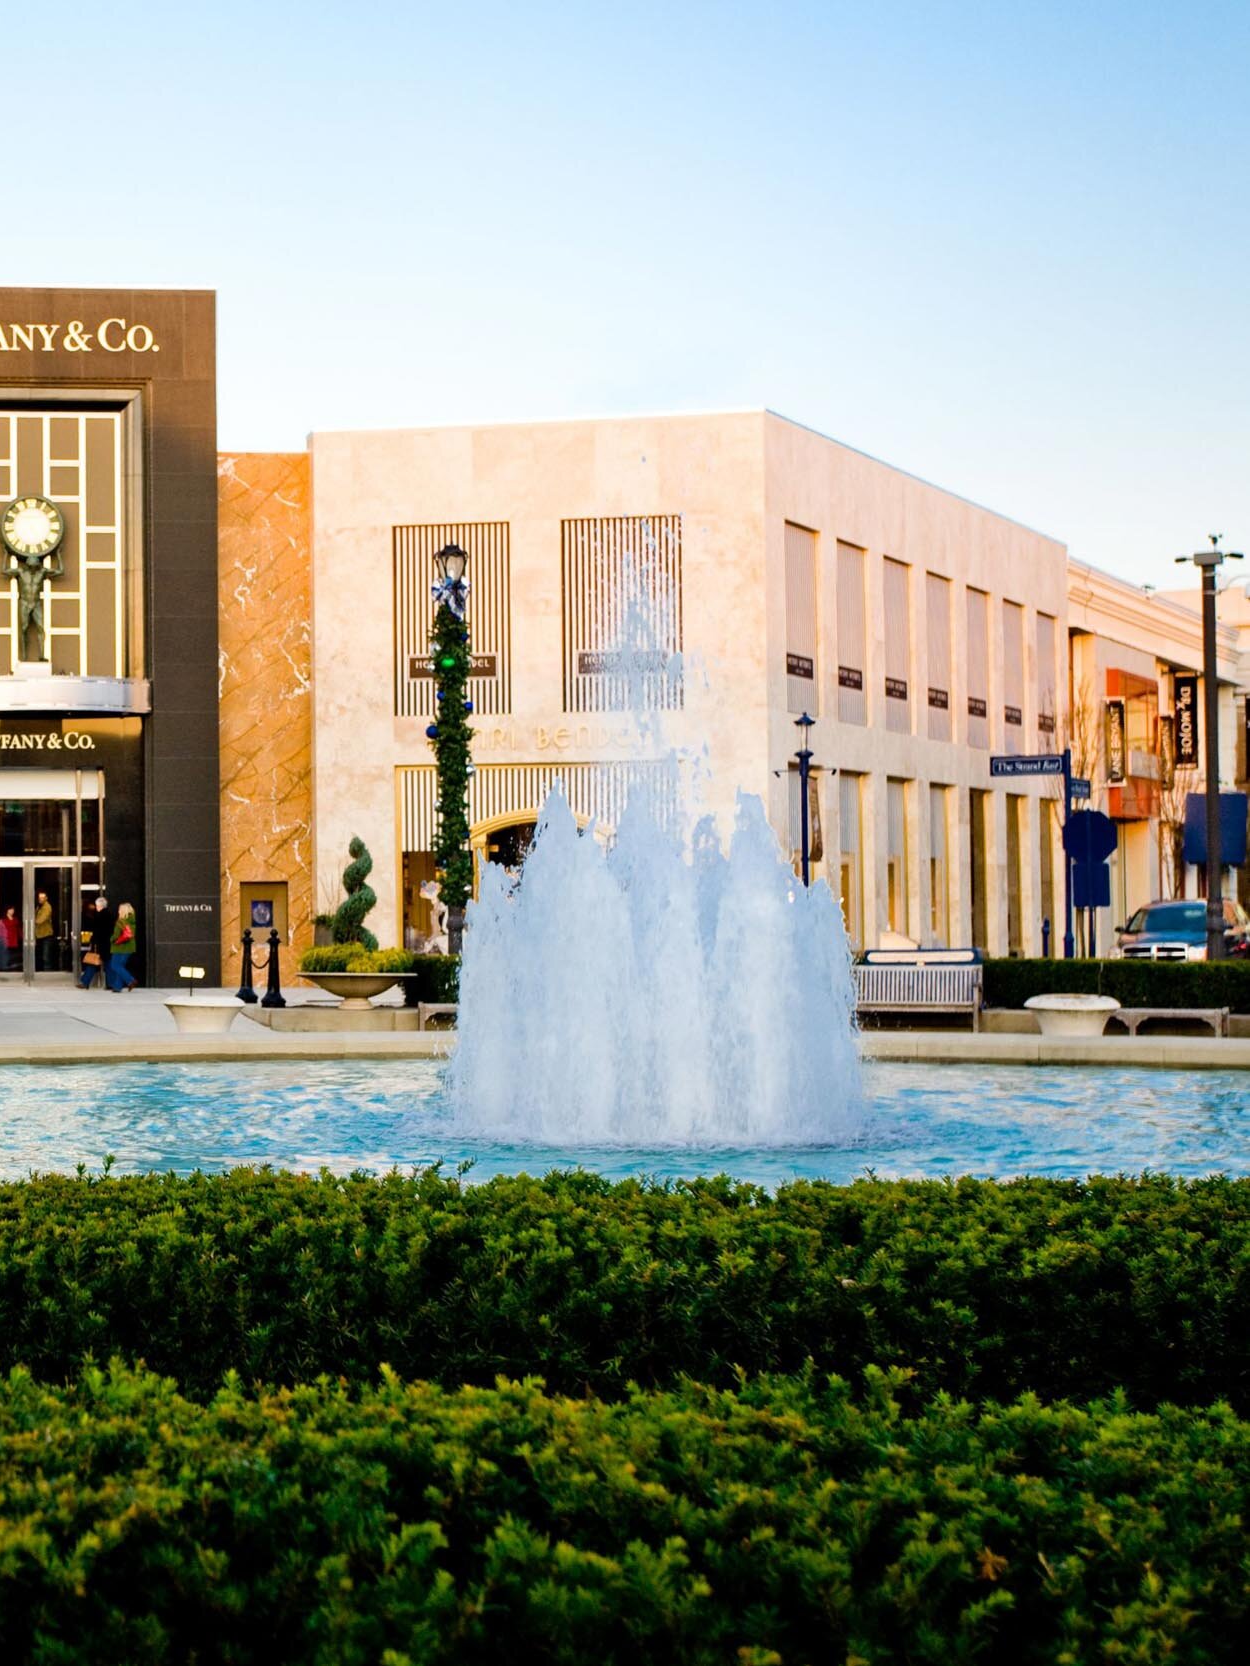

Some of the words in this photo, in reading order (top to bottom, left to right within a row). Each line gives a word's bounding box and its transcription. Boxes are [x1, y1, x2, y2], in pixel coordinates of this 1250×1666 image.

[62, 320, 93, 352] &
[97, 318, 160, 353] CO.
[47, 732, 62, 750] &
[64, 731, 96, 750] CO.
[1110, 706, 1121, 749] BRYANT
[1179, 711, 1192, 755] MOJOE
[997, 762, 1013, 771] The
[1015, 761, 1040, 771] Strand
[1111, 750, 1121, 779] LANE
[165, 904, 193, 912] TIFFANY
